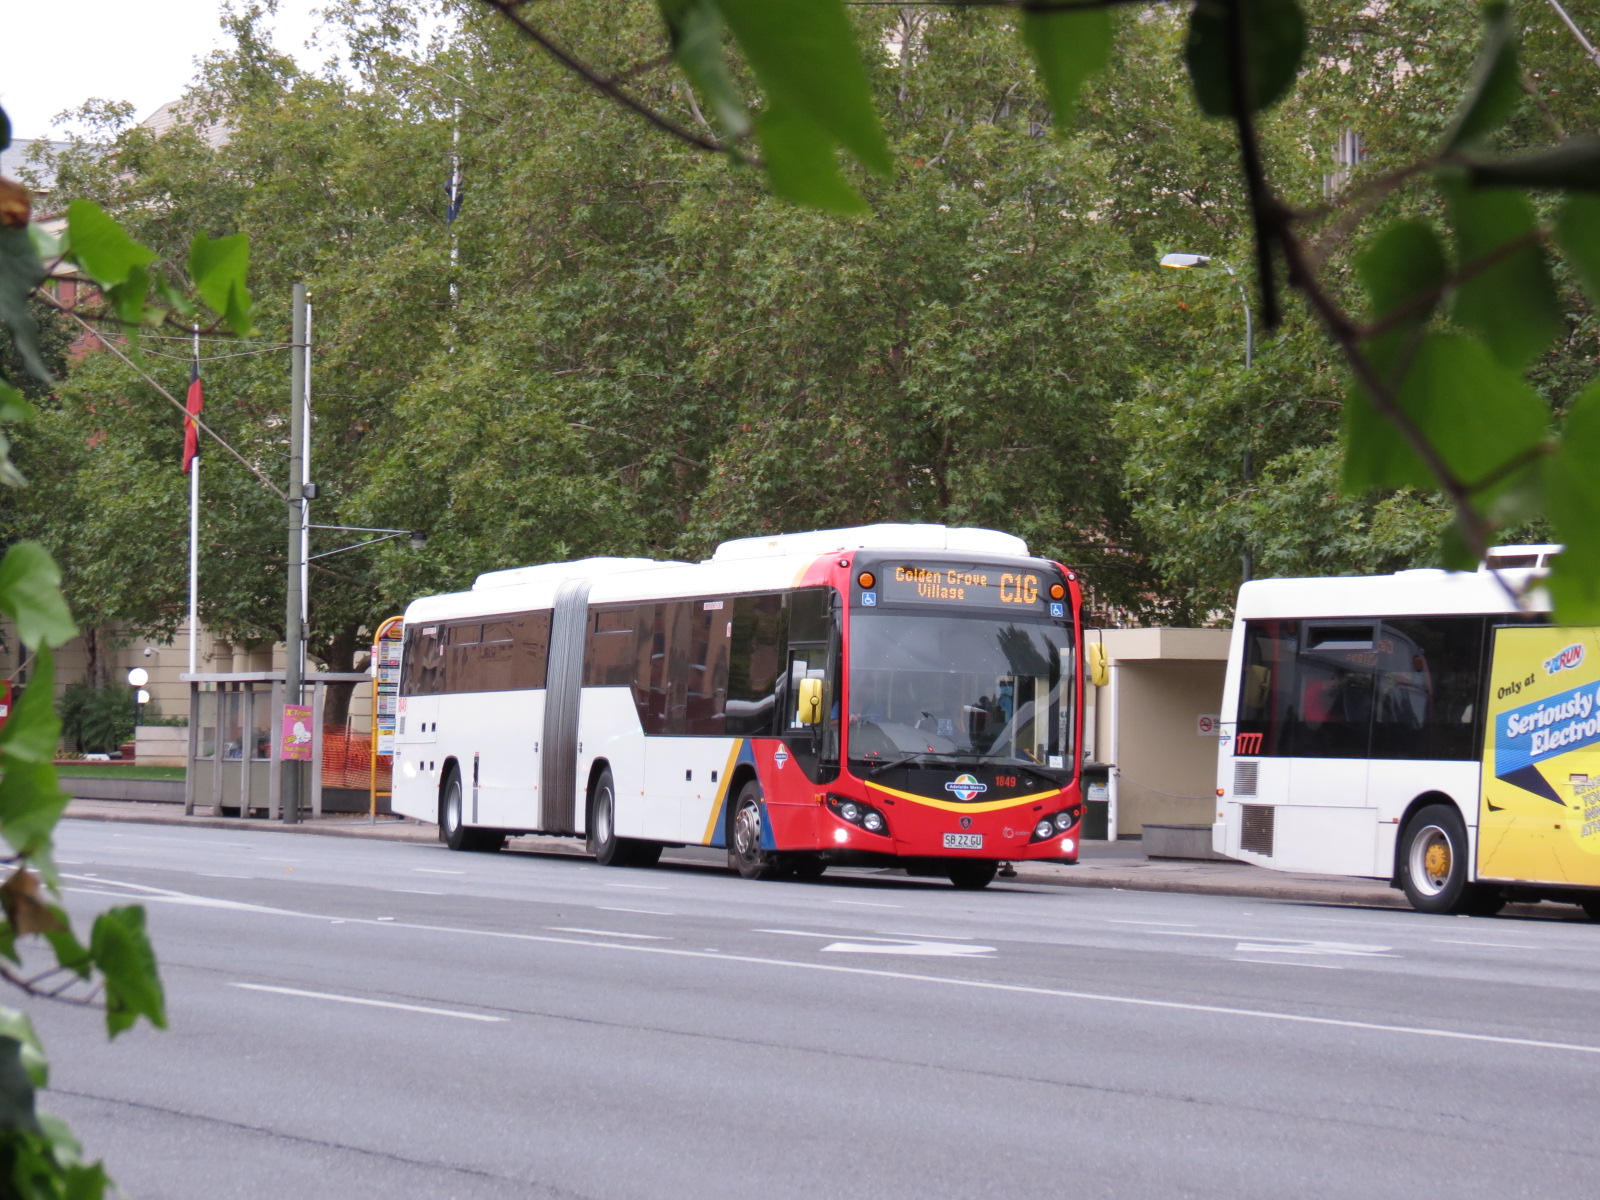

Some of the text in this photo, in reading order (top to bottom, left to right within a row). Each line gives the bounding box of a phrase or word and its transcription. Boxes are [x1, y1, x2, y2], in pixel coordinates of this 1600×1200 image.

[895, 566, 988, 587] Golden Grove
[917, 583, 965, 600] Village
[1000, 573, 1039, 604] C1G
[1497, 672, 1536, 700] Only at
[1506, 691, 1593, 739] Seriously
[1236, 732, 1264, 755] 1777
[995, 775, 1017, 788] 1849
[945, 834, 982, 847] SB 22 GU
